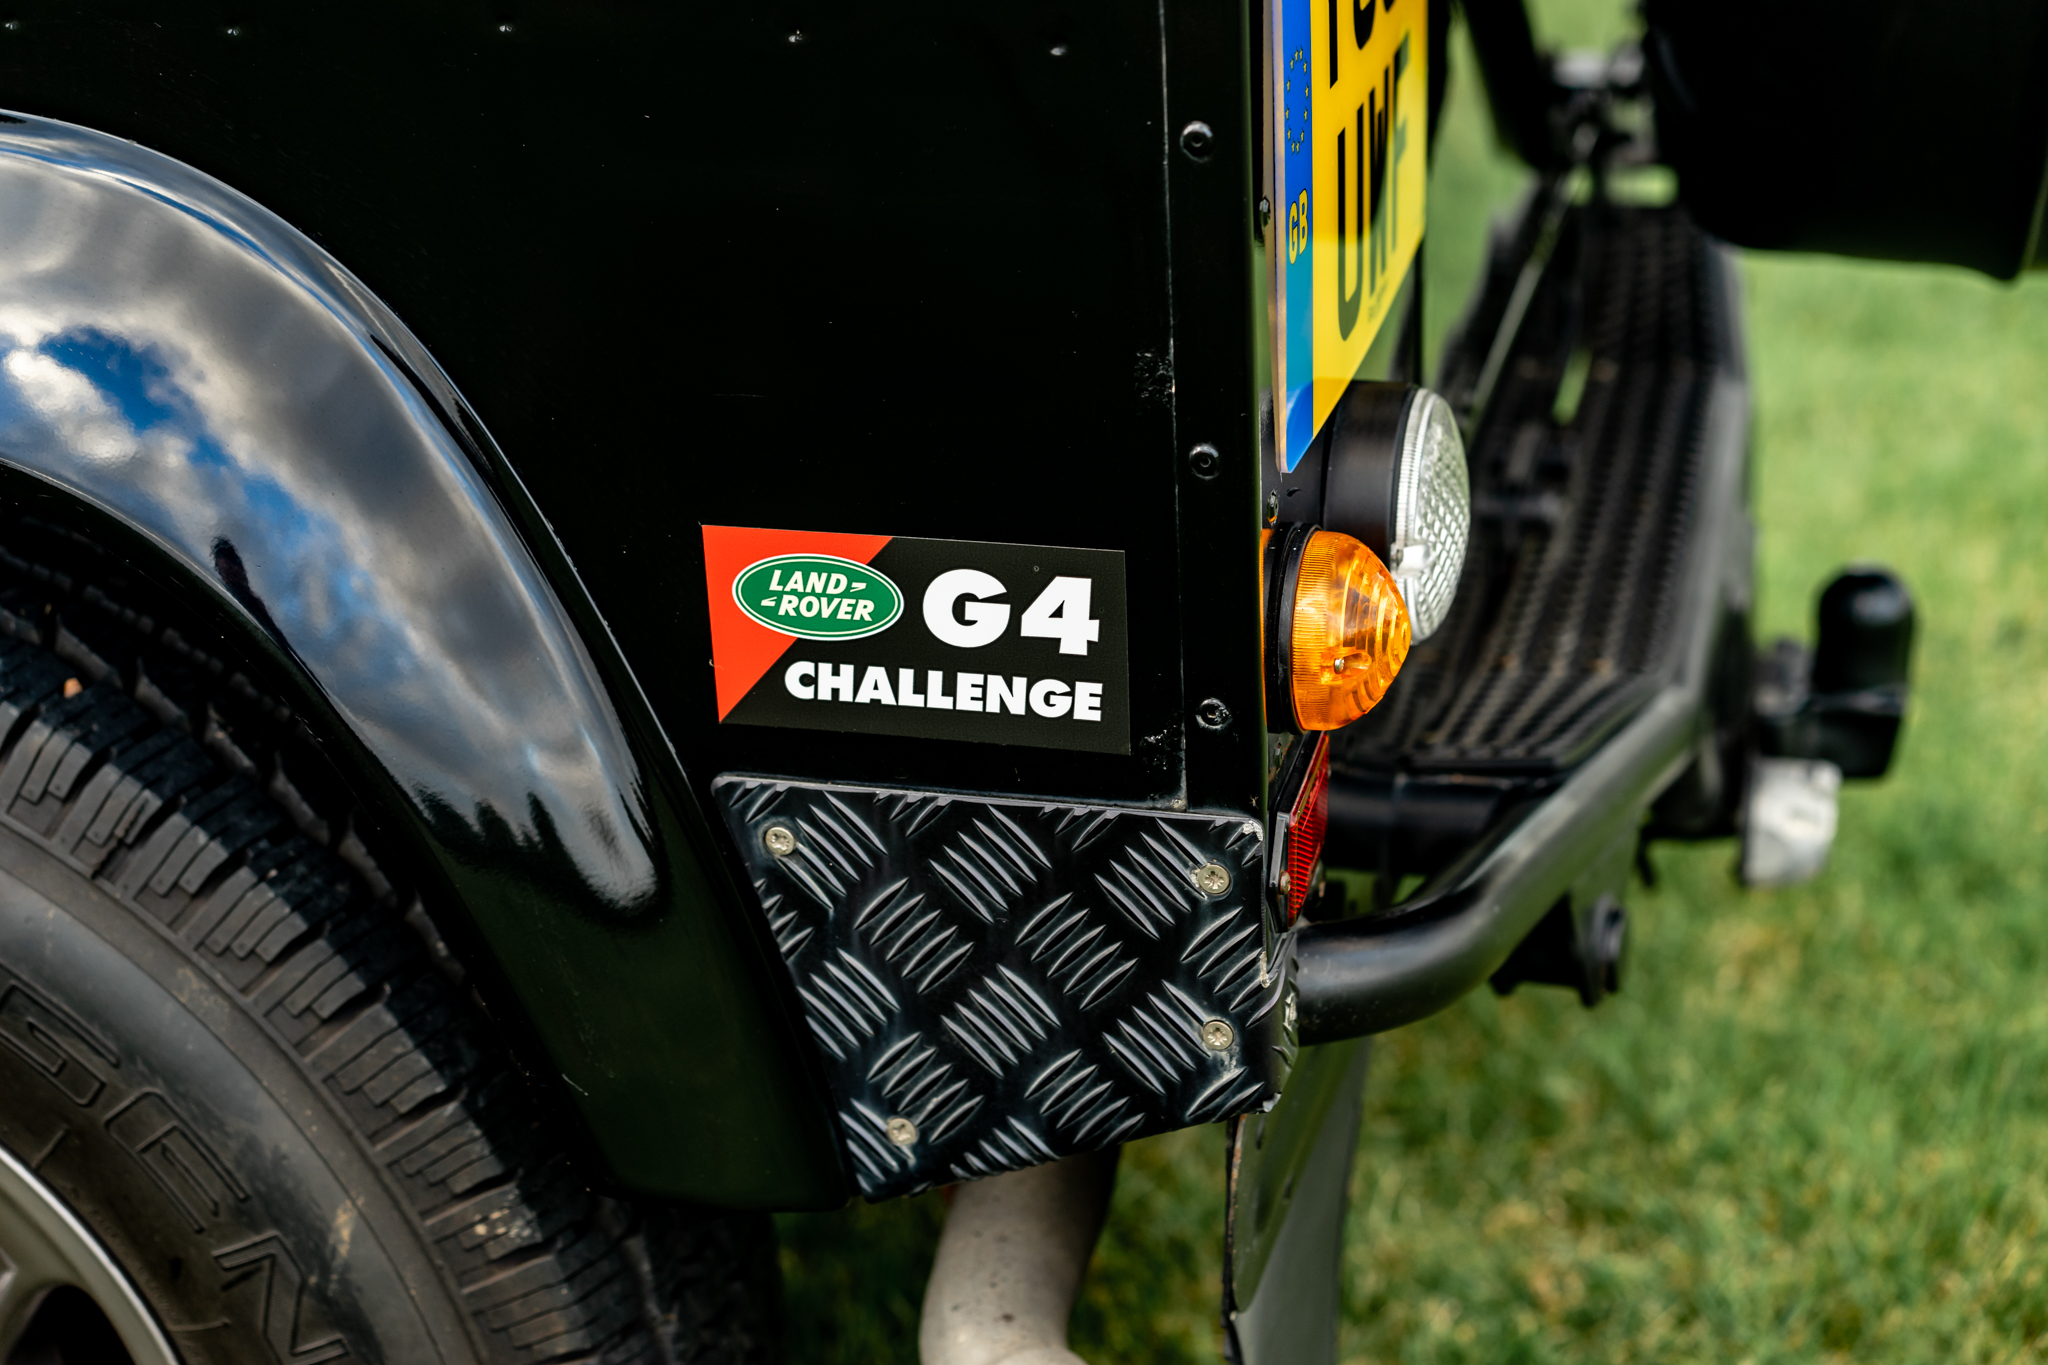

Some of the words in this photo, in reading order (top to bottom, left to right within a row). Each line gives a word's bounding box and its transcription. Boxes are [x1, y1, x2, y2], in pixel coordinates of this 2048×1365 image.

[1337, 29, 1411, 342] UWF
[1288, 188, 1308, 265] GB
[769, 569, 848, 595] LAND
[778, 594, 875, 622] ROVER
[922, 568, 1100, 656] G4
[784, 660, 1104, 722] CHALLENGE
